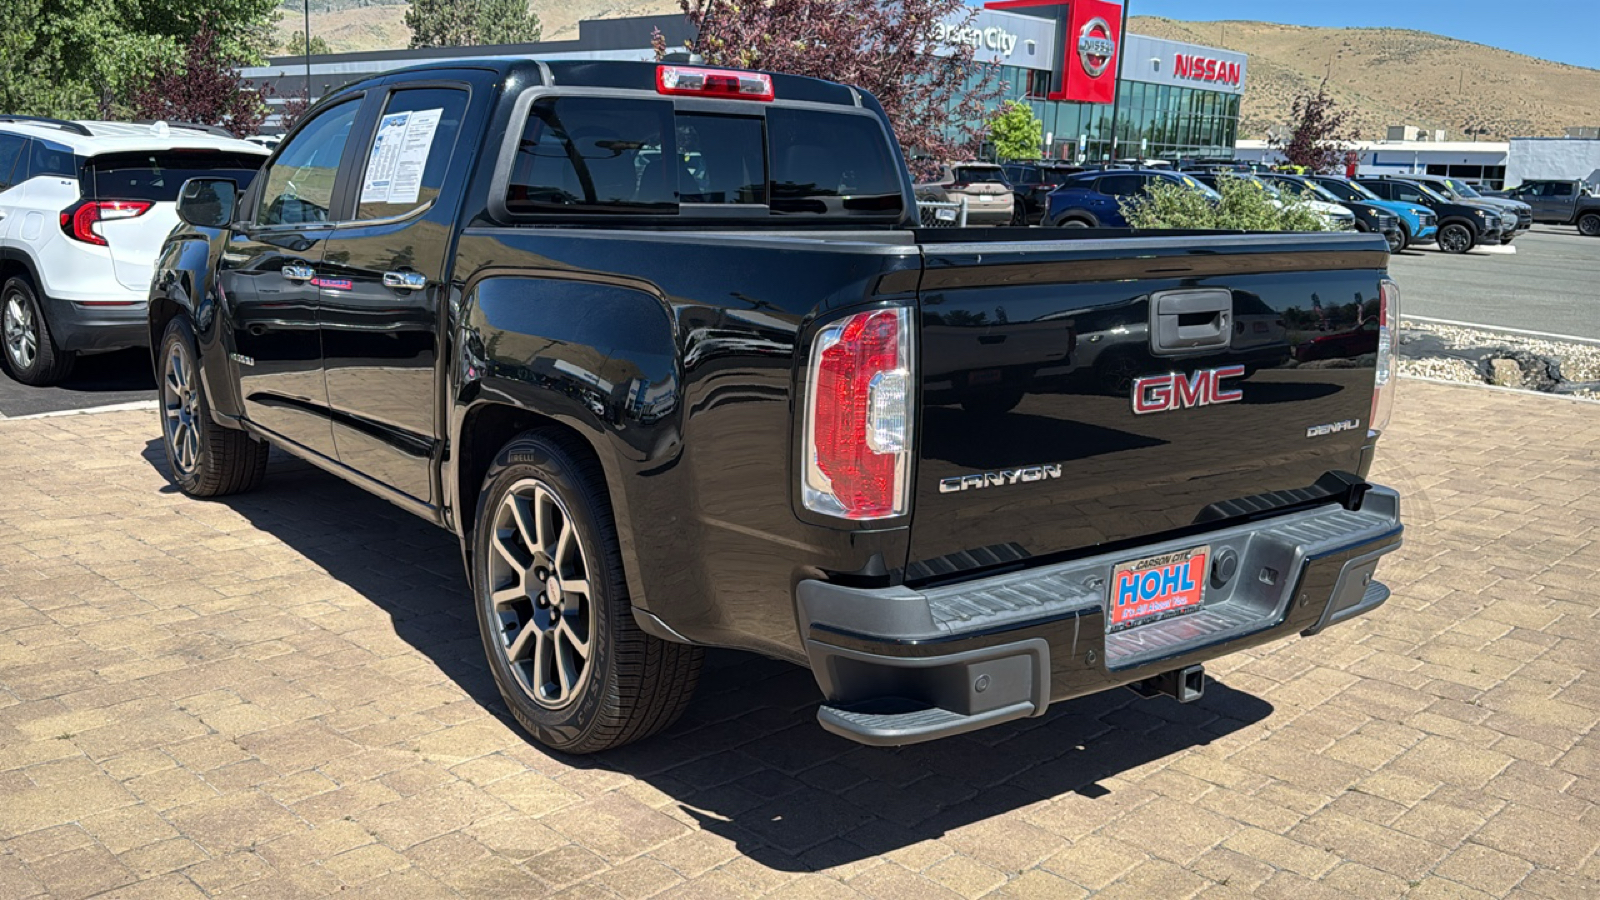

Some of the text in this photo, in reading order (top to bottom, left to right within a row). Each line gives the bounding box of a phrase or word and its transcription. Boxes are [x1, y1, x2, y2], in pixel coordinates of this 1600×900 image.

[984, 26, 1018, 56] City
[1174, 52, 1240, 85] NISSAN
[1132, 364, 1245, 414] GMC
[1306, 419, 1360, 437] DENALI
[939, 464, 1062, 493] CANYON
[1136, 555, 1172, 570] CARSON
[1118, 562, 1195, 606] HOHL
